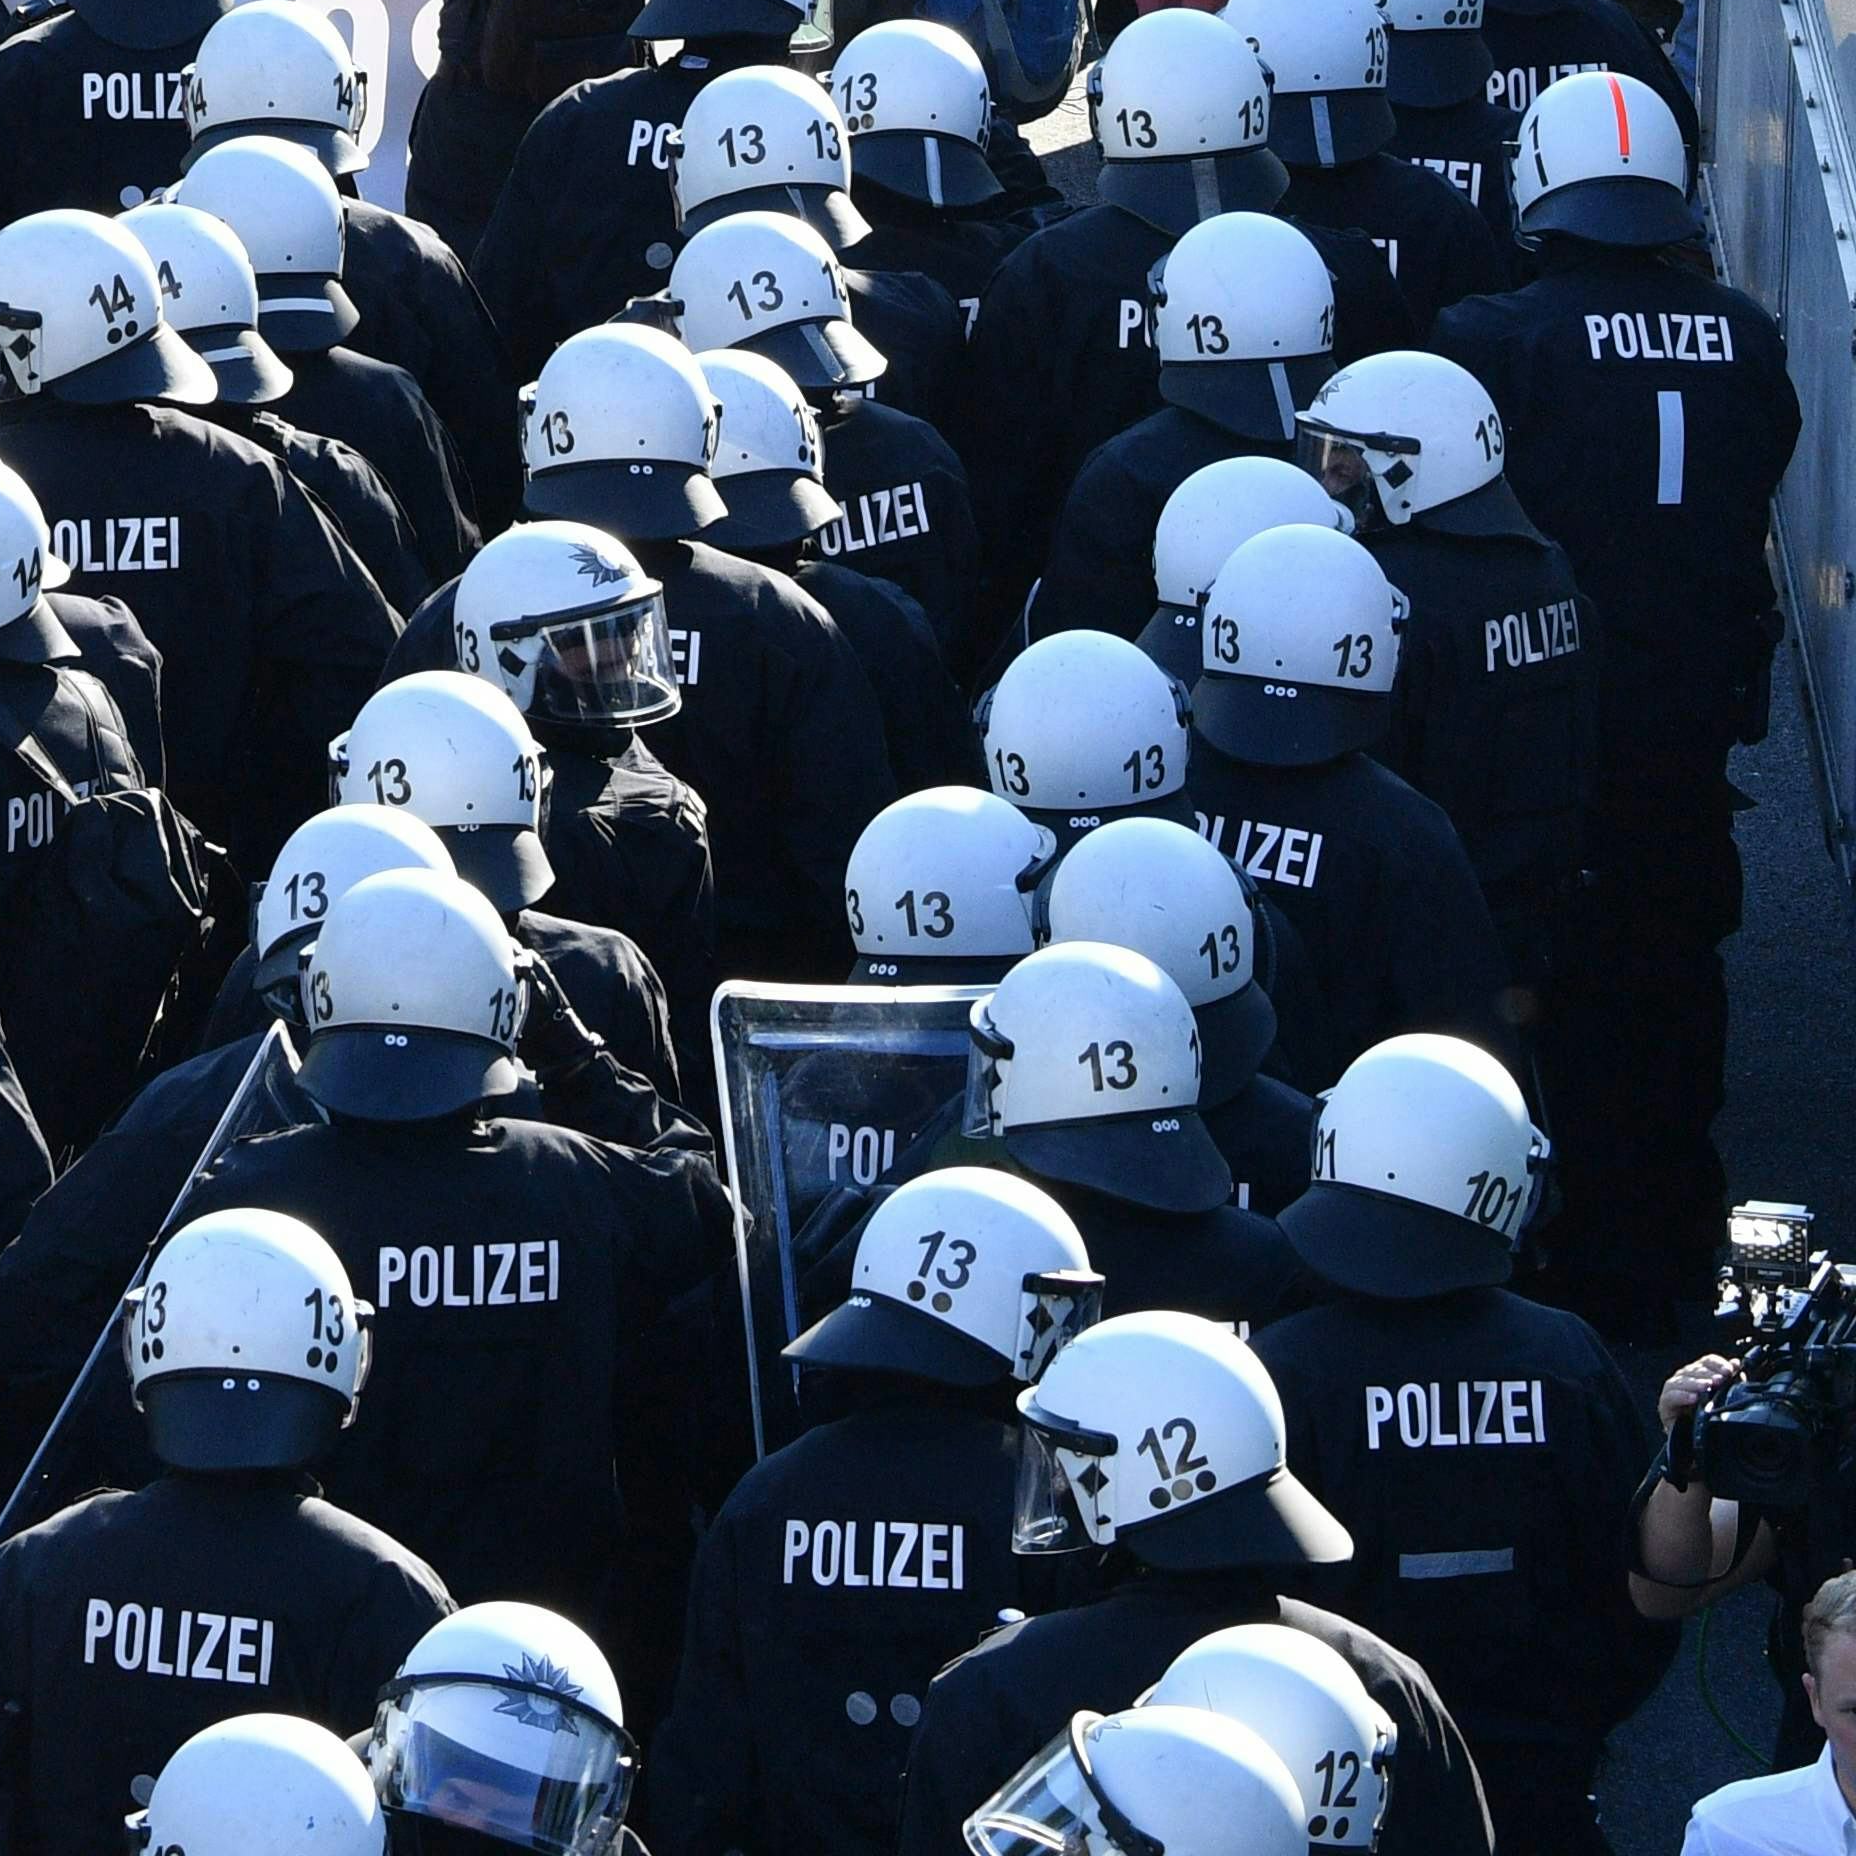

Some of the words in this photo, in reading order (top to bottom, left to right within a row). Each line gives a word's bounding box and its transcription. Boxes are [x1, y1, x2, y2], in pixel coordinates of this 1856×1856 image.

[83, 72, 185, 121] POLIZ
[840, 74, 878, 116] 13
[1238, 98, 1265, 140] 13
[717, 126, 766, 168] 13
[807, 118, 841, 160] 13
[1117, 108, 1157, 149] 13
[89, 276, 135, 325] 14
[158, 262, 182, 299] 4
[727, 270, 784, 320] 13
[1186, 314, 1228, 354] 13
[1588, 314, 1734, 362] POLIZEI
[541, 412, 575, 455] 13
[1476, 414, 1502, 461] 13
[52, 517, 181, 572] OLIZEI
[13, 548, 43, 598] 14
[1210, 614, 1240, 662] 13
[1333, 635, 1373, 677] 13
[1485, 597, 1580, 672] POLIZEI
[368, 759, 411, 807] 13
[996, 749, 1029, 795] 13
[1124, 745, 1165, 790] 13
[284, 873, 328, 919] 13
[847, 890, 864, 935] 3
[896, 892, 954, 937] 13
[1200, 927, 1241, 976] 13
[489, 987, 515, 1040] 13
[1079, 1041, 1138, 1091] 13
[1315, 1116, 1337, 1180] 01
[378, 1241, 559, 1307] POLIZEI
[917, 1232, 976, 1288] 13
[305, 1288, 345, 1347] 13
[1366, 1381, 1545, 1450] POLIZEI
[1136, 1419, 1207, 1480] 12
[784, 1520, 963, 1589] POLIZEI
[85, 1599, 274, 1684] POLIZEI
[1313, 1752, 1359, 1807] 12
